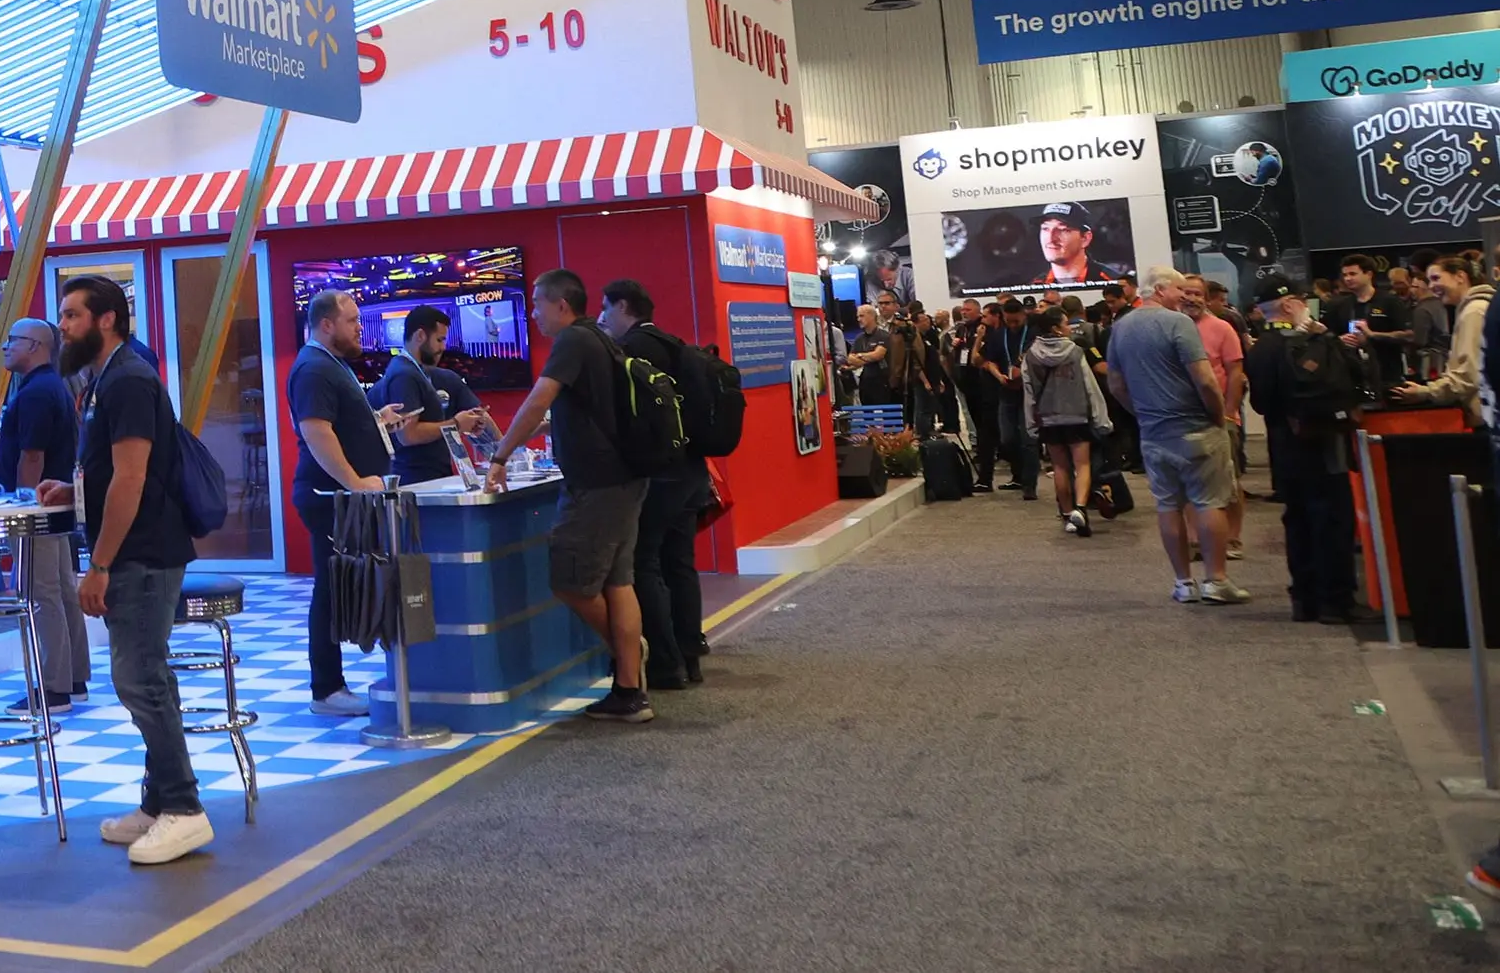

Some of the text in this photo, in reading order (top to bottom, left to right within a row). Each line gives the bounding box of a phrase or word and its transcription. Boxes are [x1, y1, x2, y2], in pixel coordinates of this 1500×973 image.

[994, 14, 1044, 36] The
[222, 32, 306, 81] Marketplace
[1366, 59, 1485, 87] GoDaddy
[959, 137, 1146, 171] shopmonkey
[952, 178, 1112, 199] Shop Management Software
[1403, 182, 1484, 227] Golf
[718, 241, 785, 274] Walmart Marketplace
[455, 290, 504, 306] LET'S GROW
